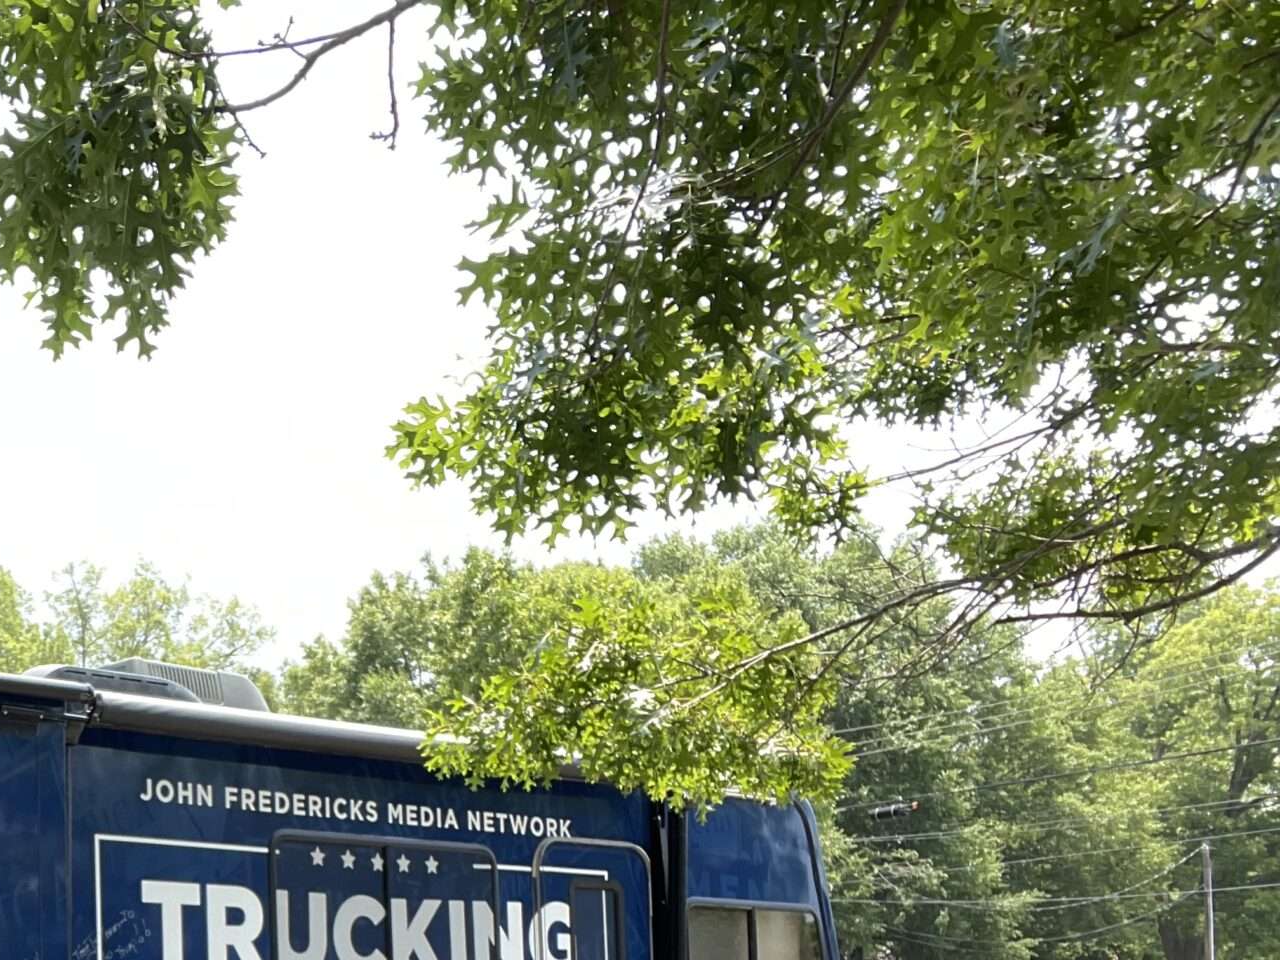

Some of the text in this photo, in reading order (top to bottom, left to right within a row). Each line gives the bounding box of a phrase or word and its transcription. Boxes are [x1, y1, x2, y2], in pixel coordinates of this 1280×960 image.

[140, 778, 572, 838] JOHN FREDERICKS MEDIA NETWORK
